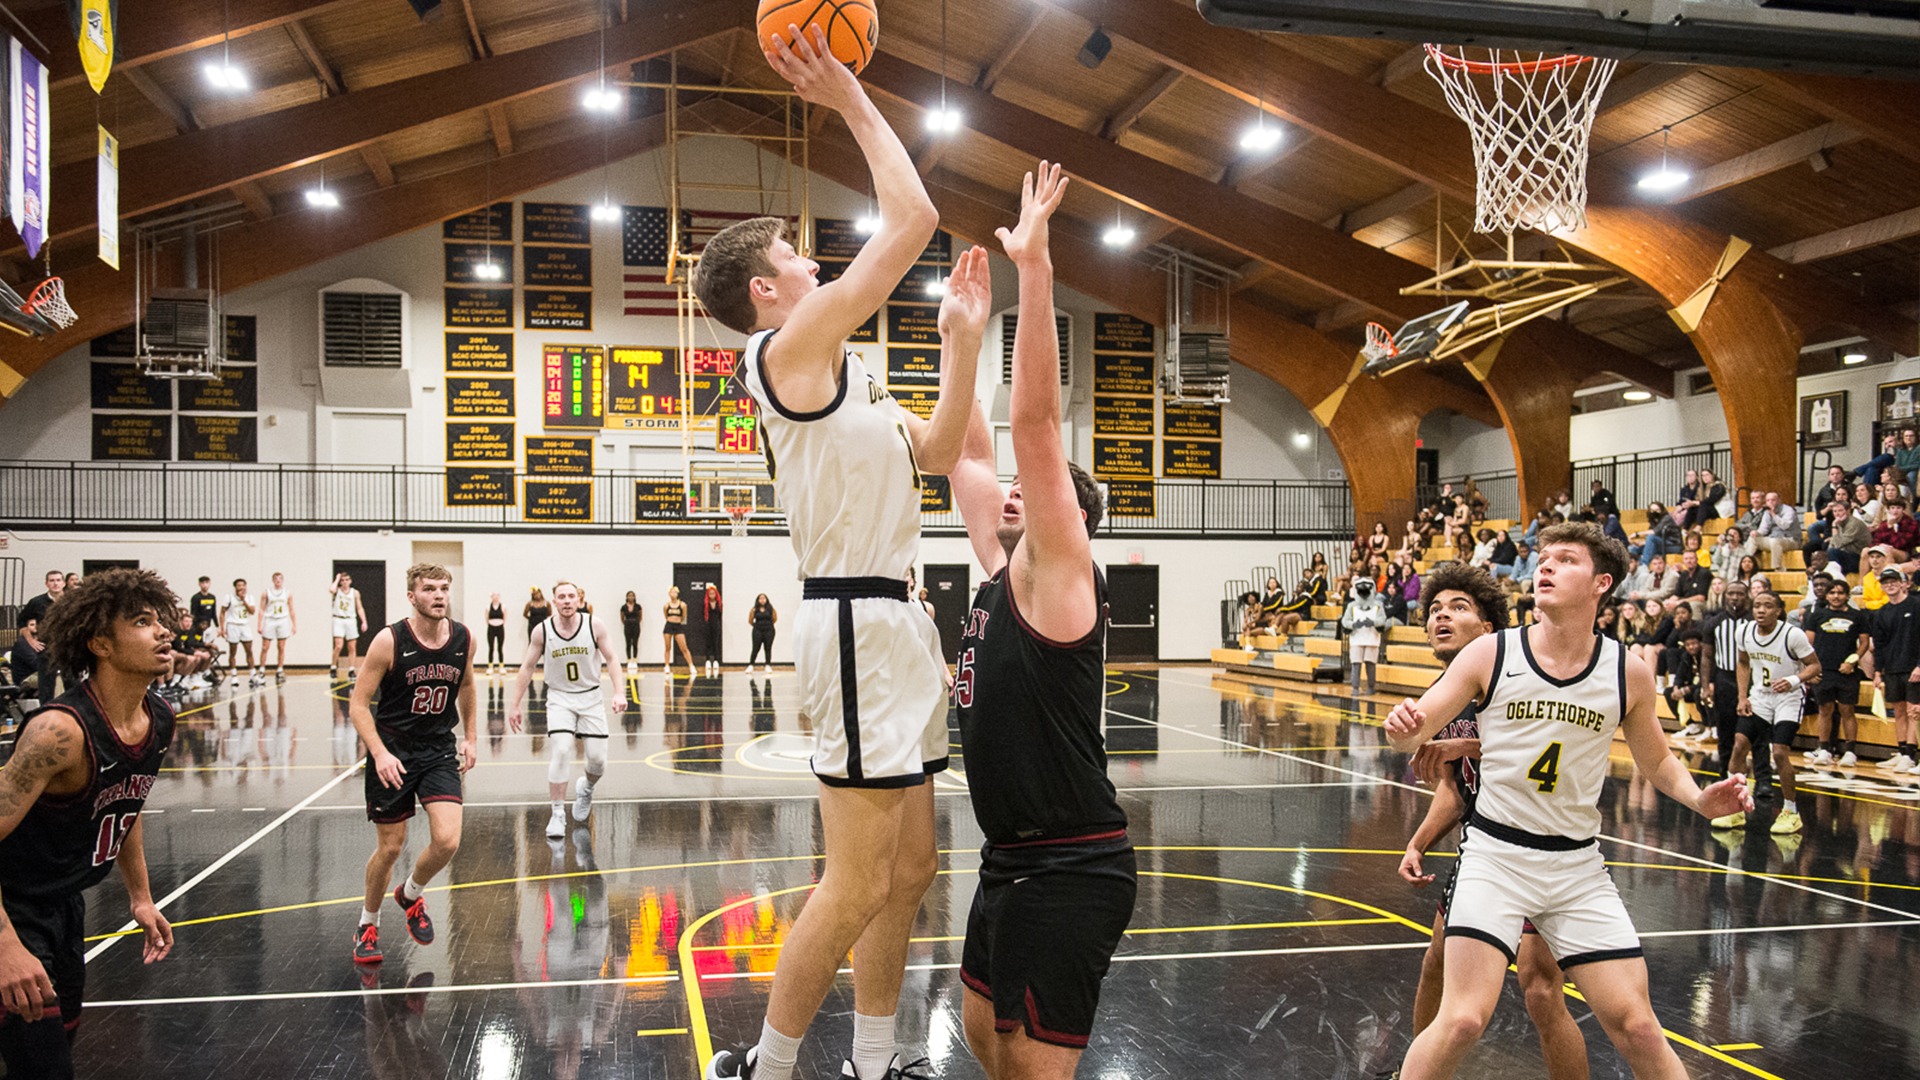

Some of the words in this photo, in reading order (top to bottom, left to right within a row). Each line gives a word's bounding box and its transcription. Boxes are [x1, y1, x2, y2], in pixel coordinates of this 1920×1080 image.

[485, 360, 507, 368] PLACE
[613, 350, 663, 364] PIONEERS
[628, 364, 648, 388] 14
[195, 398, 240, 406] BASKETBALL
[641, 395, 654, 415] 0
[660, 396, 672, 414] 4
[739, 399, 750, 415] 4
[725, 430, 750, 450] 20
[194, 452, 240, 460] BASKETBALL
[552, 646, 588, 658] OGLETHORPE
[406, 663, 462, 686] TRANSY
[566, 662, 579, 682] 0
[1762, 666, 1771, 687] 2
[411, 686, 449, 714] 20
[1506, 700, 1605, 732] OGLETHORPE
[1526, 741, 1563, 794] 4
[92, 774, 157, 820] TRANS
